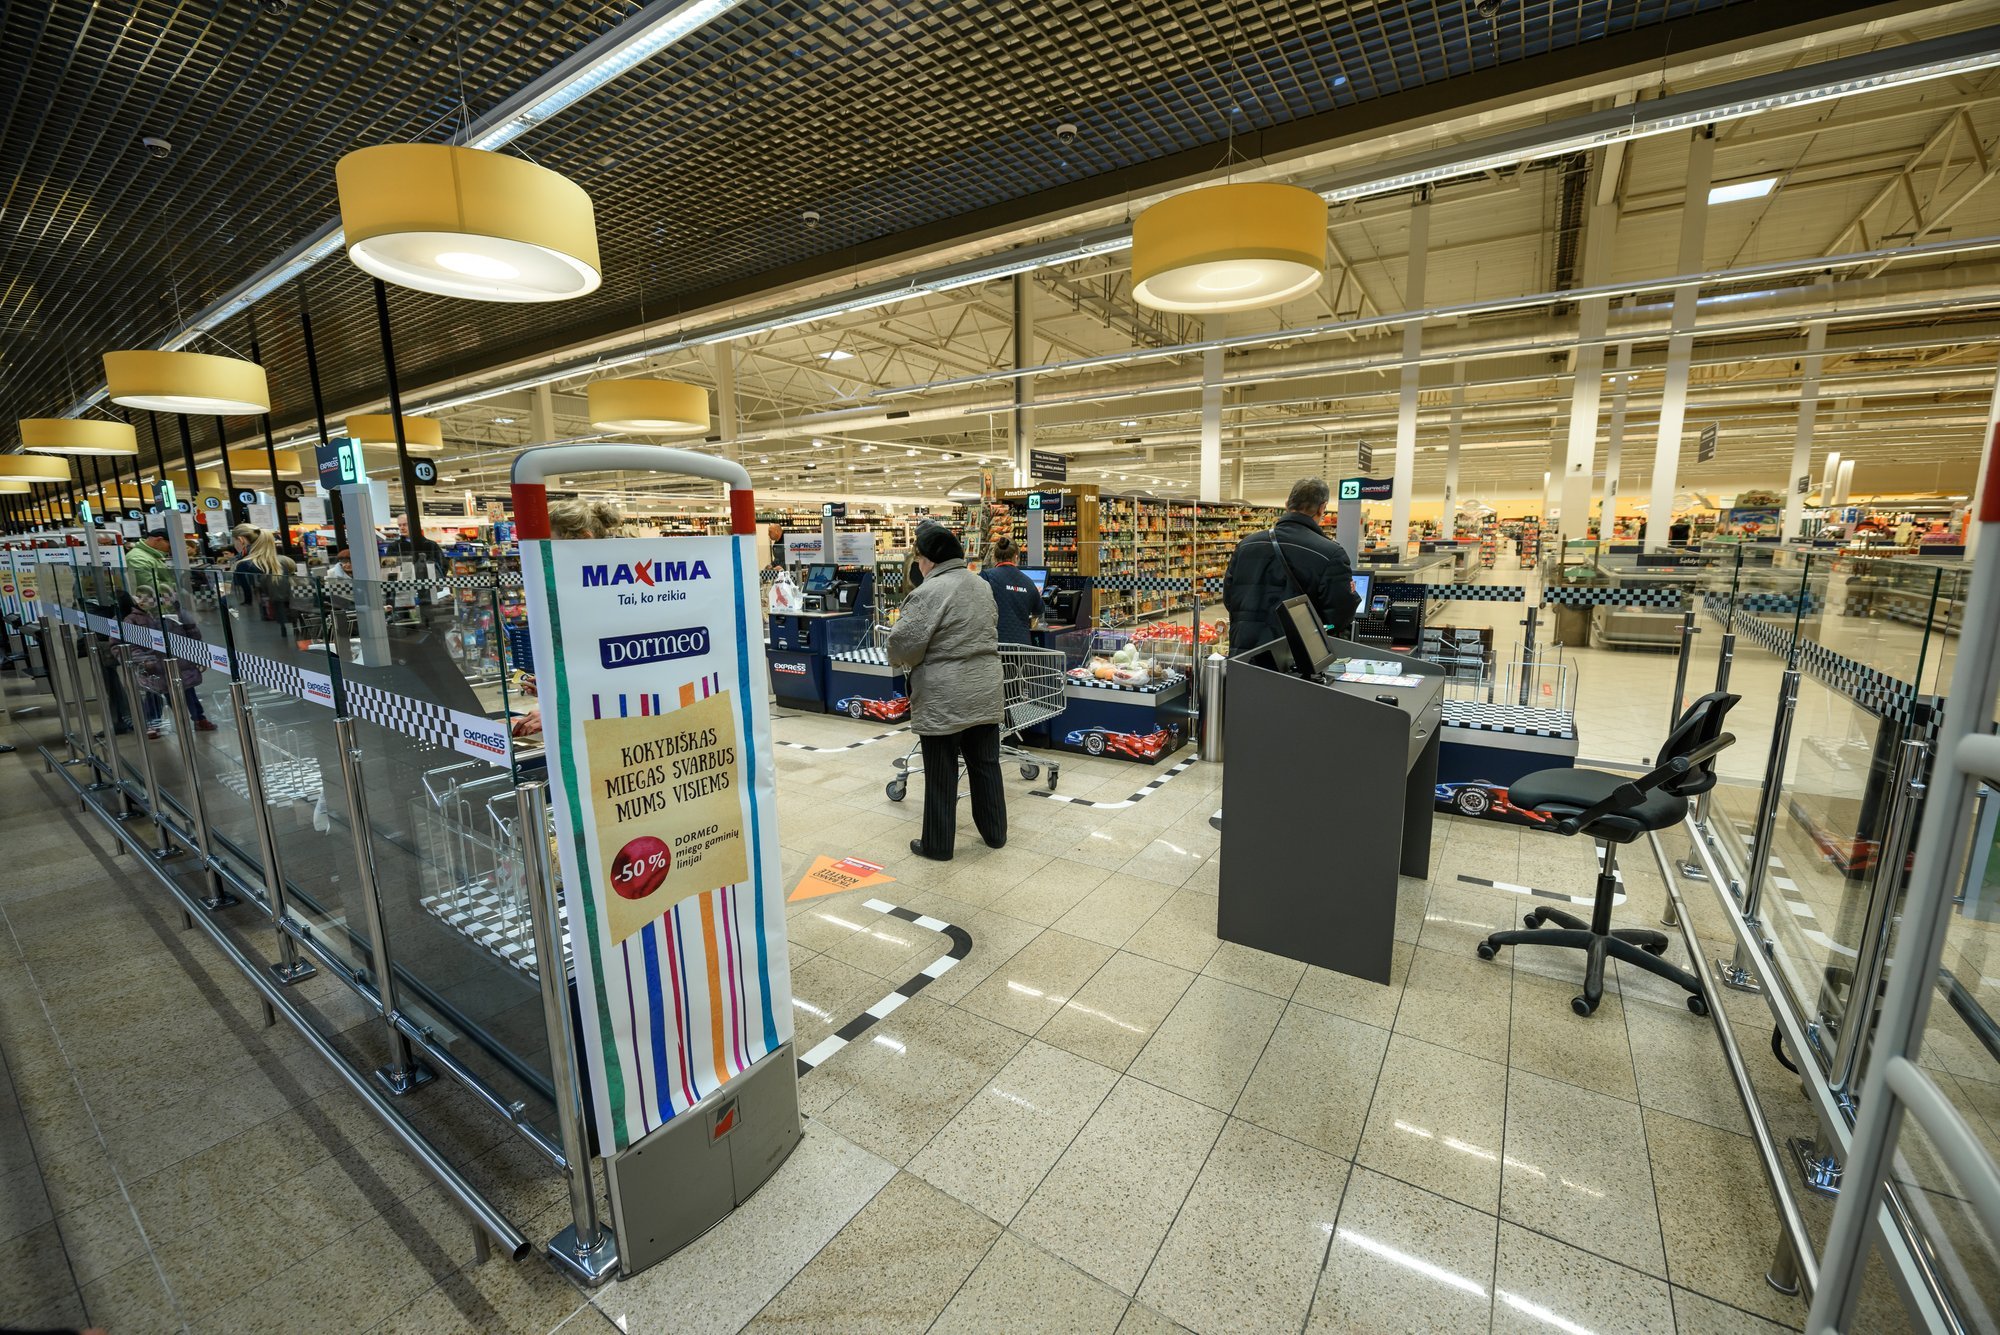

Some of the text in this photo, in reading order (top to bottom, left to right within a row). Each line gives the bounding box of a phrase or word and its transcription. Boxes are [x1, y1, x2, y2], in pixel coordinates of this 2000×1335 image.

[319, 459, 339, 471] EXPRESS
[343, 454, 354, 472] 22
[418, 467, 431, 477] 19
[287, 487, 298, 496] 17
[1344, 486, 1357, 495] 25
[208, 498, 218, 507] 15
[241, 494, 252, 502] 16
[1030, 498, 1039, 506] 24
[178, 502, 187, 511] 14
[582, 558, 712, 587] MAXIMA
[1006, 584, 1028, 593] MAXIMA
[617, 589, 686, 606] Tai, ko reikia
[773, 663, 806, 672] EXPRESS
[306, 681, 331, 695] EXPRESS
[463, 728, 505, 750] EXPRESS
[621, 727, 717, 768] KOKYBIŠKAS
[605, 747, 735, 799] MIEGAS SVARBUS
[615, 771, 730, 823] MUMS VISIEMS
[675, 824, 719, 847] DORMEO
[676, 829, 739, 859] miego gaminių
[676, 852, 702, 870] linijai
